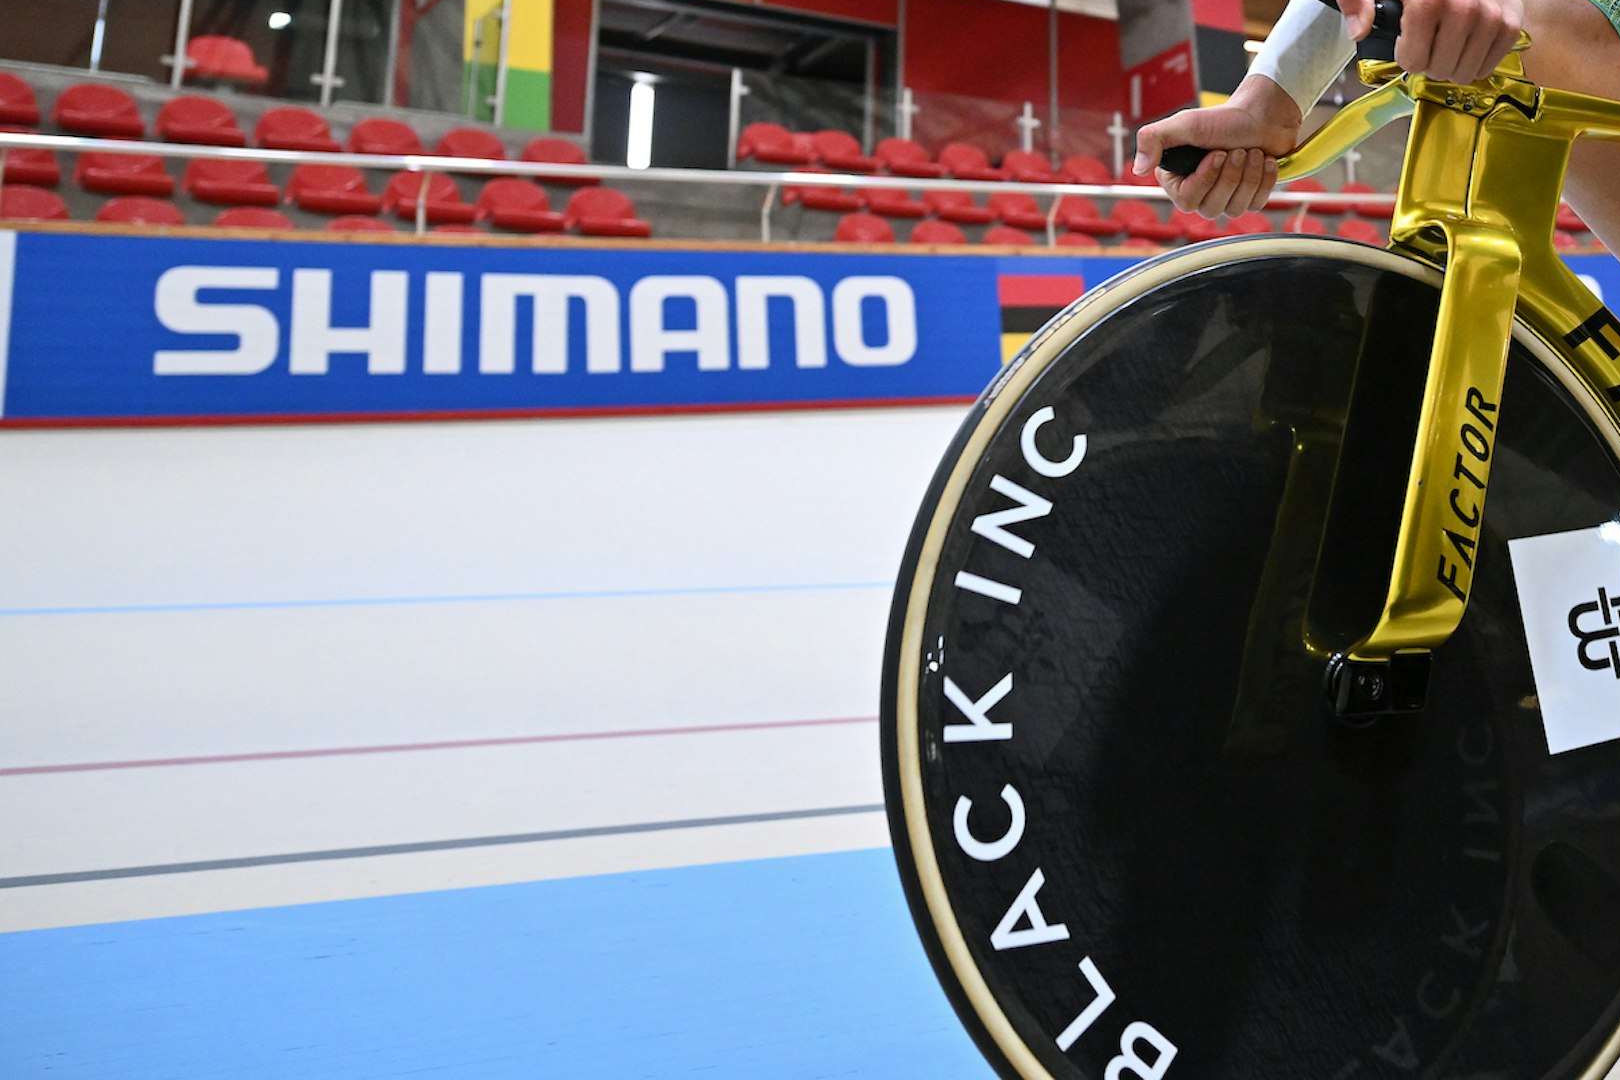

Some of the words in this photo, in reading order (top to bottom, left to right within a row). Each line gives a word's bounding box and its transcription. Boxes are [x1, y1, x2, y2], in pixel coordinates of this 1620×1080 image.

[153, 265, 917, 376] SHIMANO
[954, 406, 1088, 605] INC
[1437, 386, 1498, 604] FACTOR
[942, 673, 1179, 1080] BLACK
